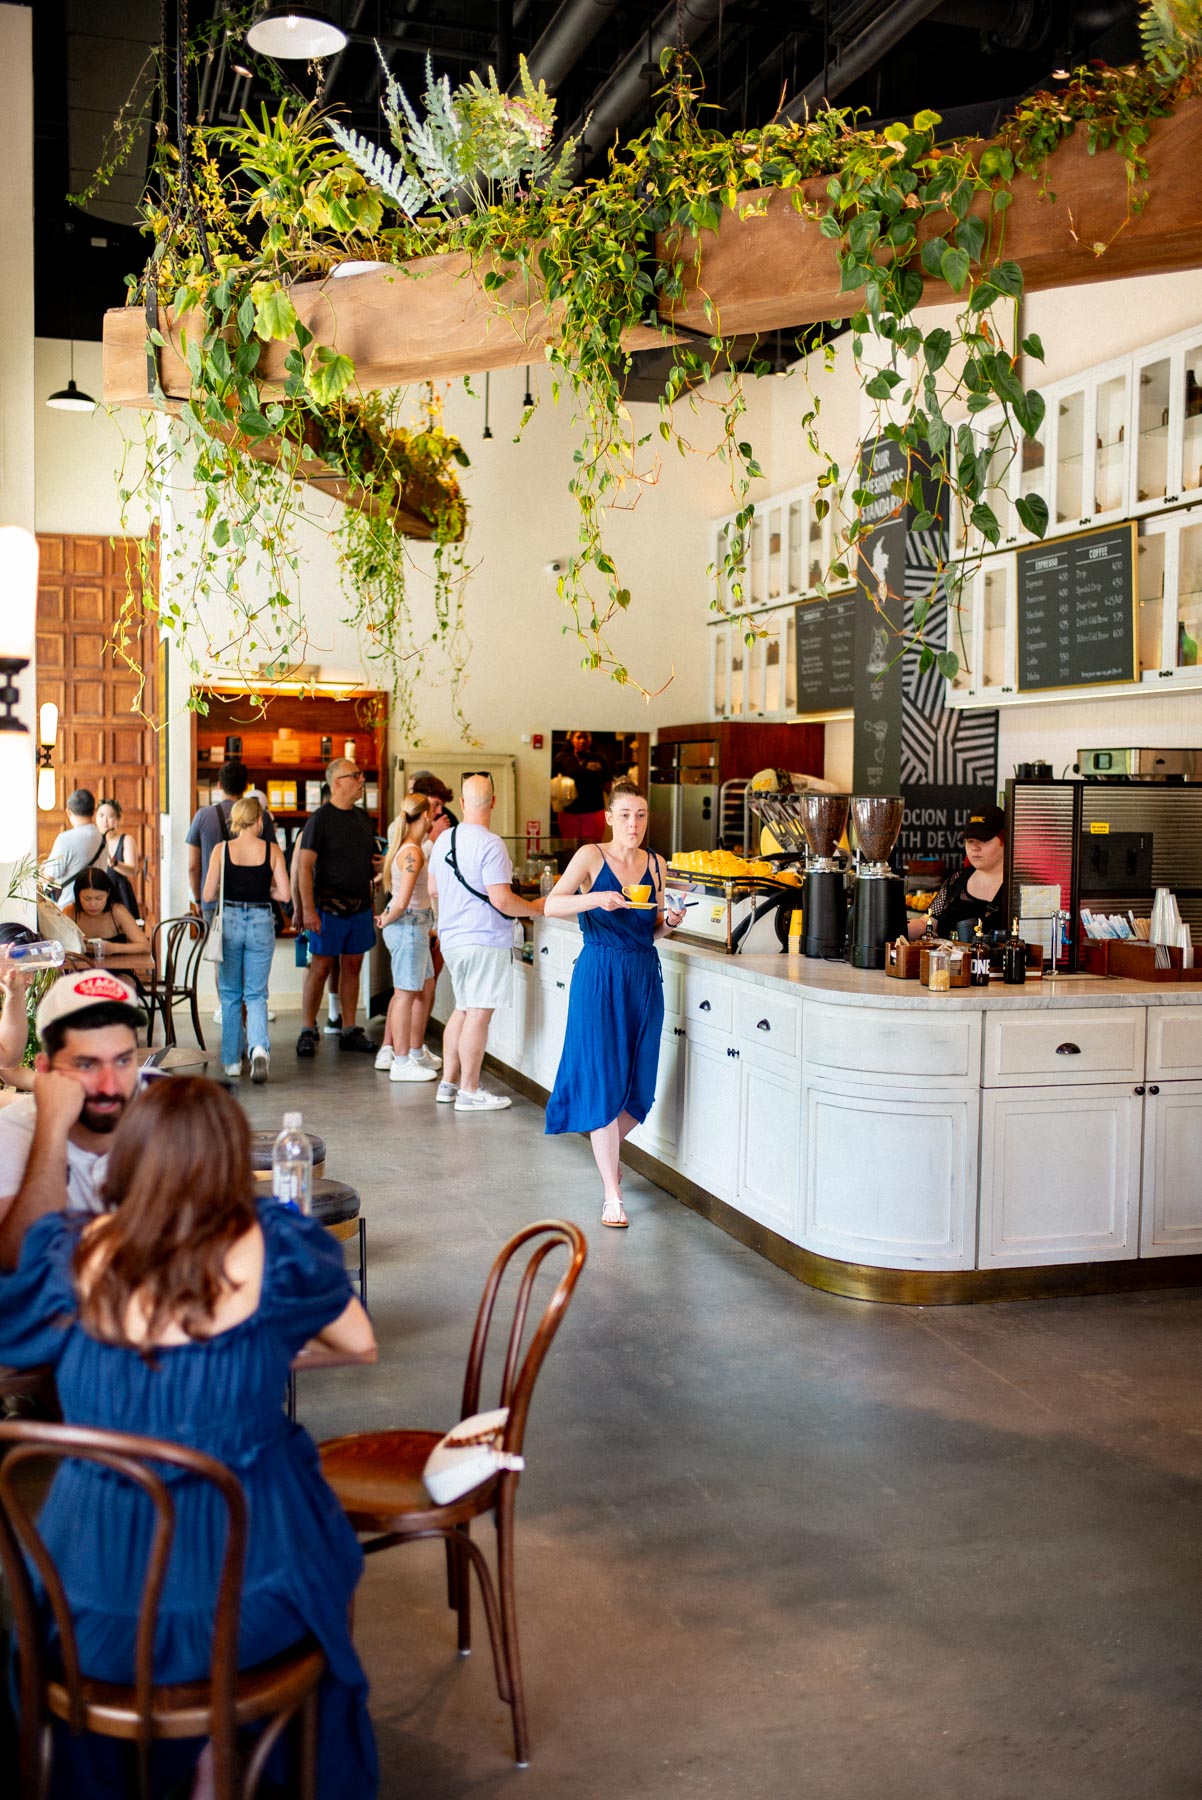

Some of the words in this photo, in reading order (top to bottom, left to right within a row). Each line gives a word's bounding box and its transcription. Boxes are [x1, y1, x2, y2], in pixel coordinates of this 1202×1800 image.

[873, 450, 890, 472] OUR
[1089, 546, 1108, 559] COFFEE
[1034, 558, 1058, 571] ESPRESSO
[902, 808, 947, 826] OCION
[954, 809, 971, 826] LI
[896, 831, 921, 848] ITH
[927, 831, 965, 849] DEVO
[971, 959, 990, 975] ONE
